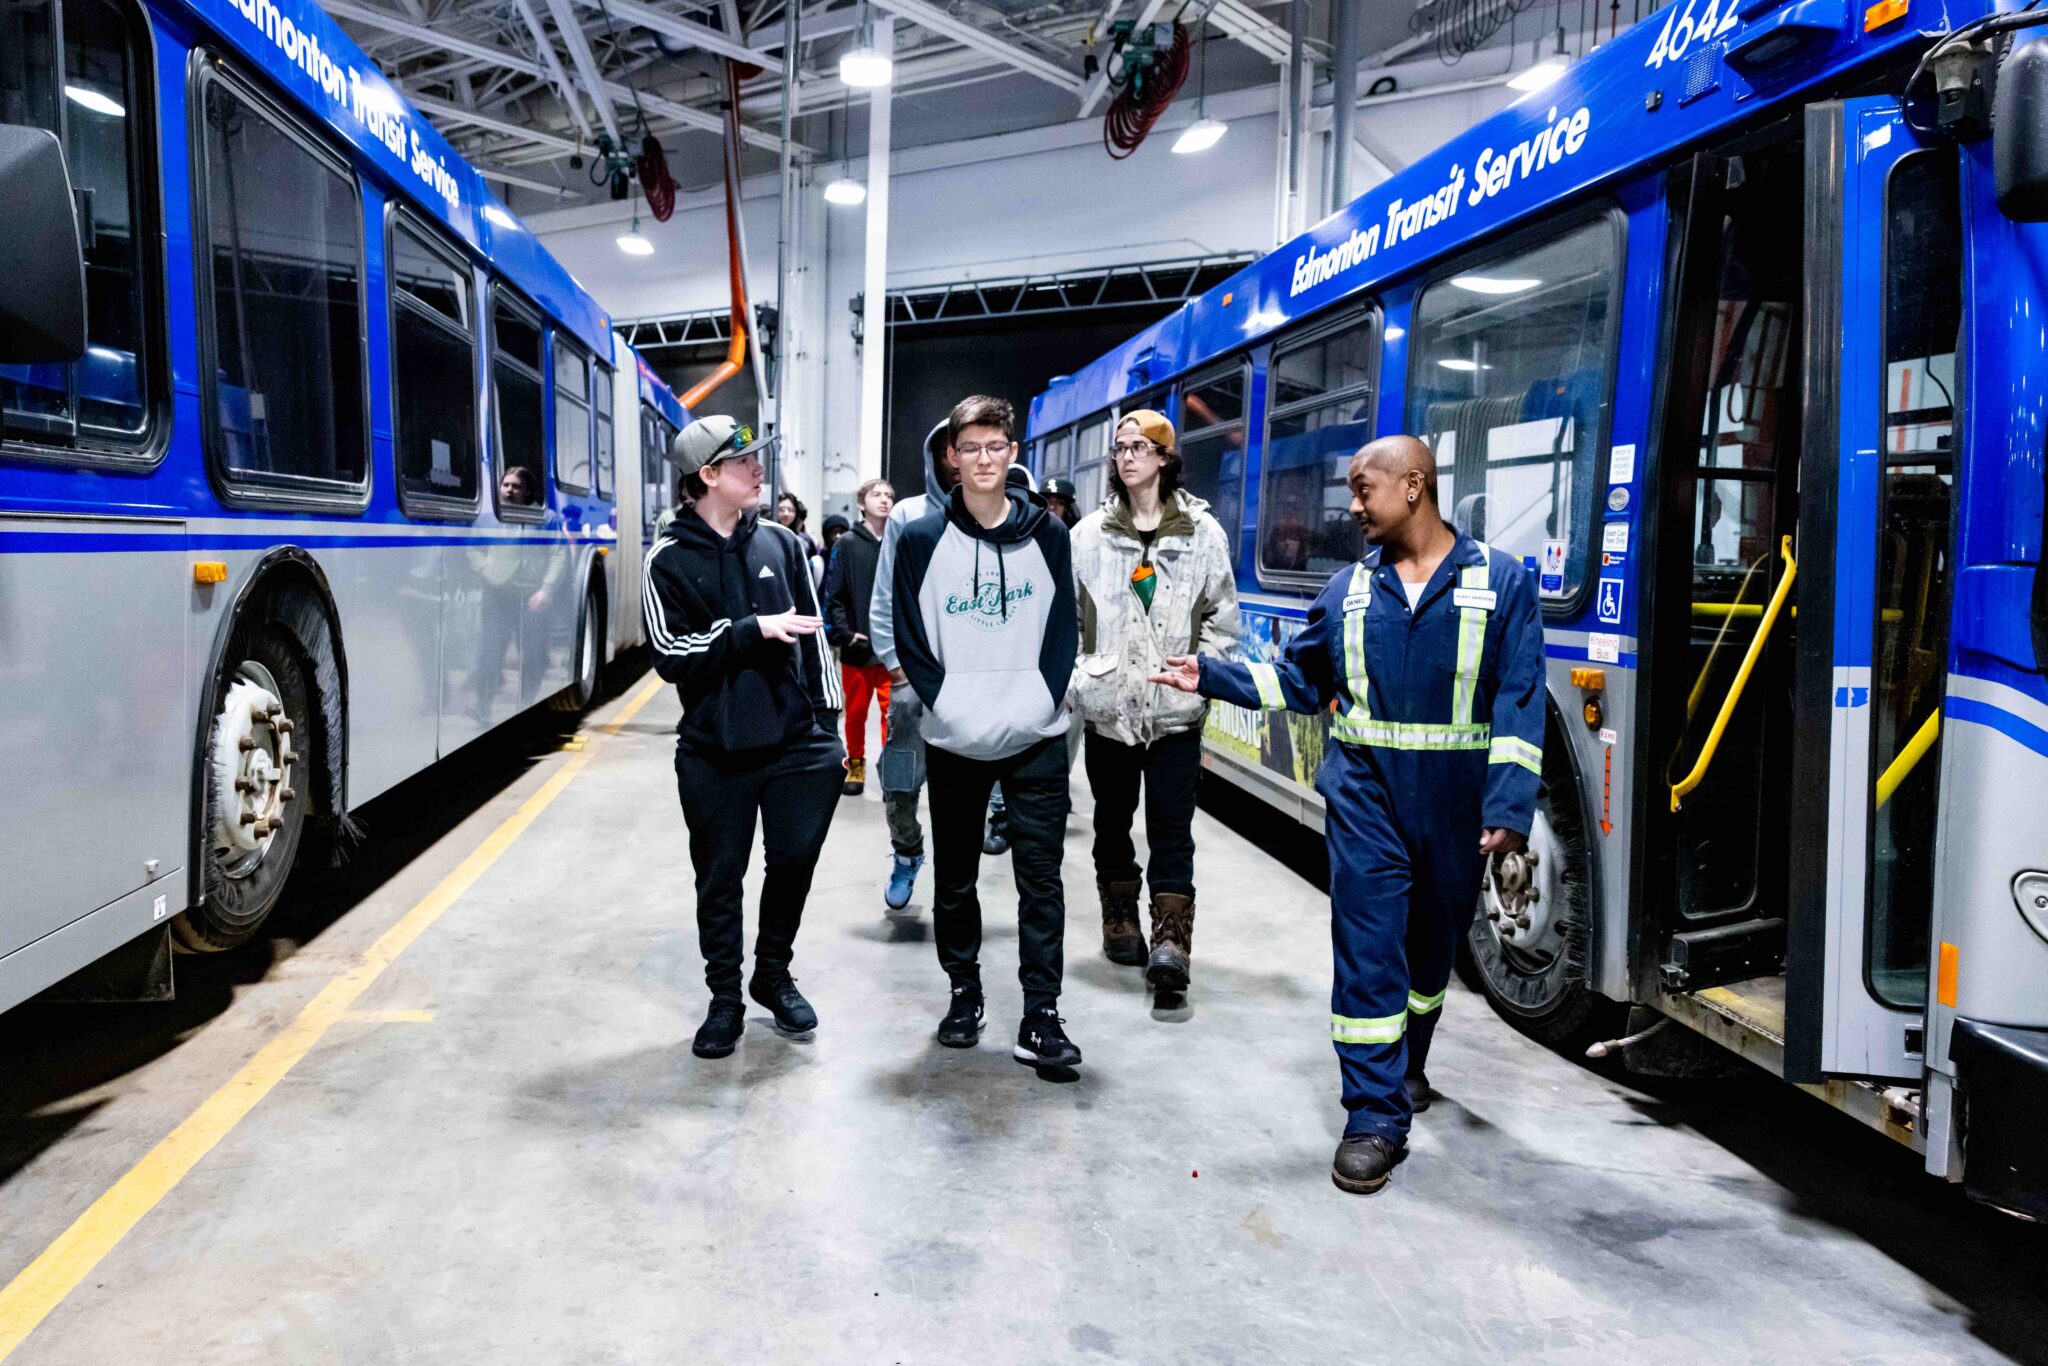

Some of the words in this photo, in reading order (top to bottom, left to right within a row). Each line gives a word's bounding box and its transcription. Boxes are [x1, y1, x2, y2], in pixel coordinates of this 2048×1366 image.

[227, 0, 347, 107] dmonton
[349, 65, 407, 162] Transit
[410, 129, 460, 208] Service
[1290, 223, 1380, 298] Edmonton
[1383, 162, 1466, 249] Transit
[1467, 105, 1590, 207] Service
[945, 594, 984, 615] East
[989, 581, 1033, 607] Park
[1346, 597, 1366, 606] DANIEL
[1590, 635, 1618, 651] Kneeling
[1596, 647, 1609, 660] Bus
